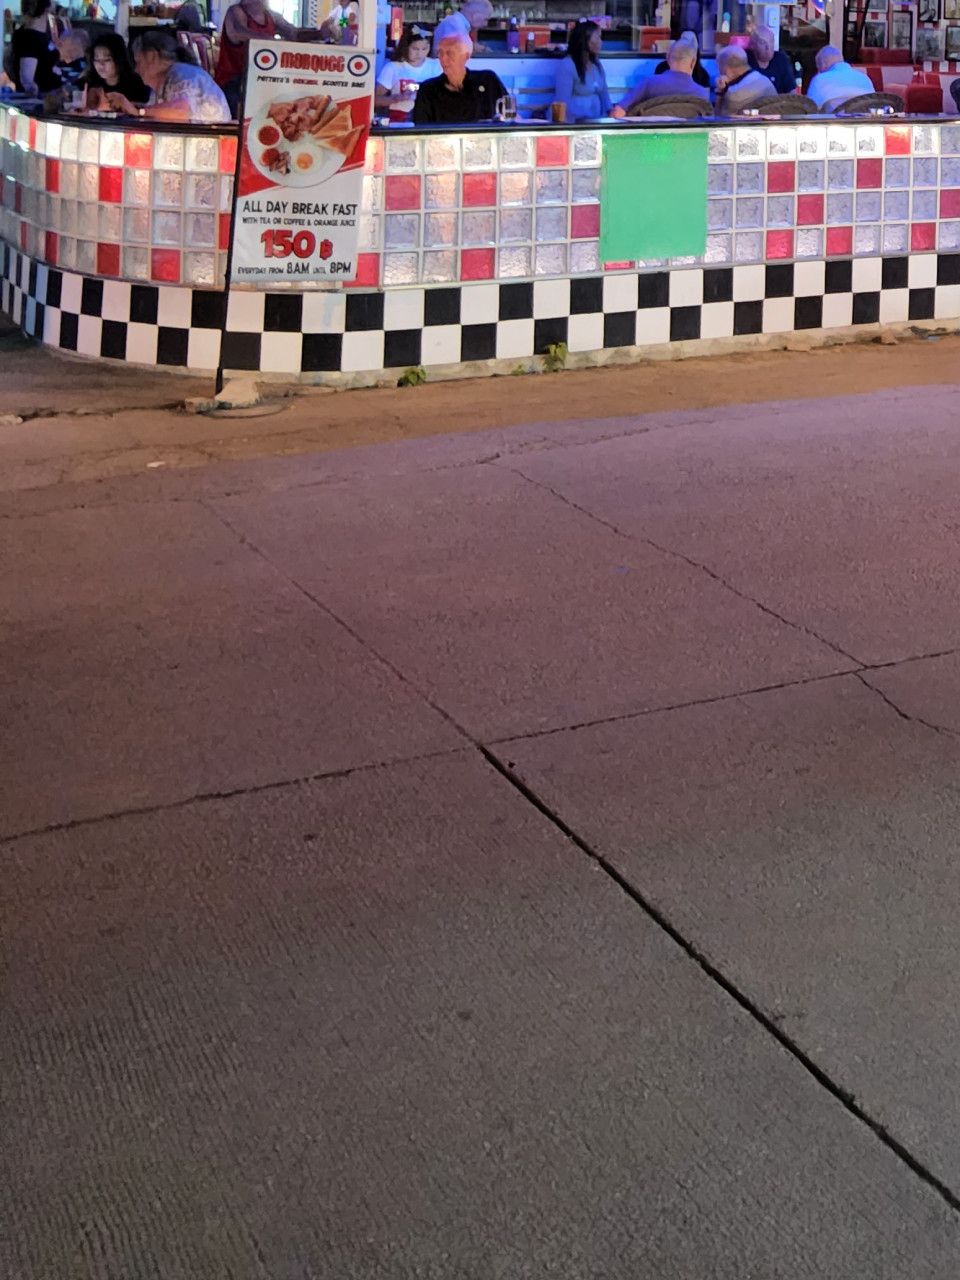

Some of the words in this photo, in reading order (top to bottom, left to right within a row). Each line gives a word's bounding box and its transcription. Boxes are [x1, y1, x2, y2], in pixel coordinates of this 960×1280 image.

[243, 200, 262, 213] ALL
[266, 201, 288, 214] DAY
[292, 202, 328, 215] BREAK
[333, 204, 358, 216] FAST
[242, 217, 258, 225] WITH
[260, 217, 271, 225] TEA
[273, 217, 282, 225] OR
[284, 218, 305, 226] COFFEE
[313, 219, 338, 227] ORANGE
[261, 229, 316, 259] 150
[287, 262, 309, 274] 8AM
[330, 261, 352, 273] 8PM
